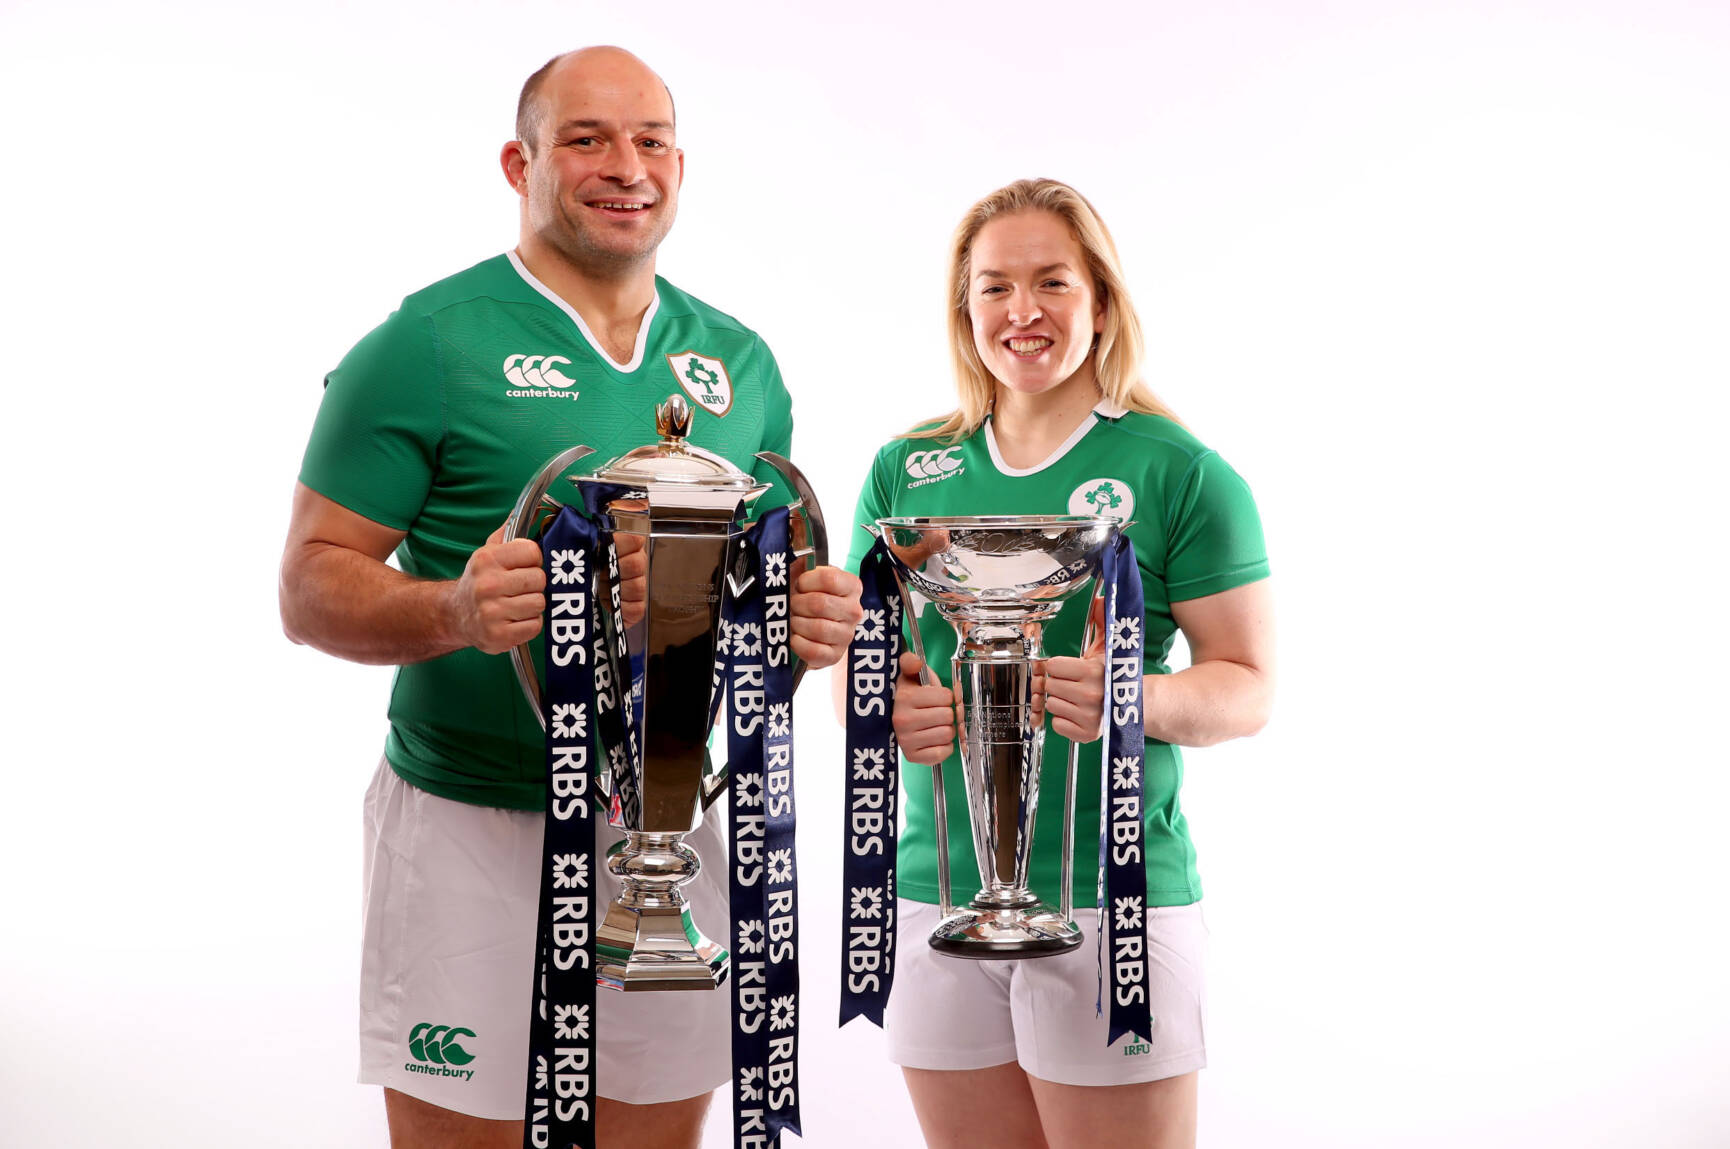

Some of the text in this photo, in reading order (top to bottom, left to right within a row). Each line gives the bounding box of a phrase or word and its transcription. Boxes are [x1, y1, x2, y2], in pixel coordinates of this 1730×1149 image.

[506, 388, 580, 401] canterbury
[701, 393, 726, 405] IRFU
[906, 466, 967, 489] canterbury
[551, 593, 588, 667] RBS
[764, 595, 789, 668] RBS
[733, 665, 766, 737] RBS
[853, 648, 885, 717] RBS
[1111, 657, 1140, 727] RBS
[552, 747, 589, 821] RBS
[767, 743, 792, 818] RBS
[736, 814, 766, 887] RBS
[851, 787, 883, 856] RBS
[1112, 796, 1141, 867] RBS
[553, 896, 589, 971] RBS
[767, 891, 795, 965] RBS
[848, 926, 881, 994] RBS
[738, 961, 766, 1034] RBS
[1115, 937, 1145, 1007] RBS
[405, 1061, 474, 1082] canterbury
[554, 1047, 590, 1122] RBS
[767, 1035, 795, 1112] RBS
[1124, 1043, 1151, 1056] IRFU
